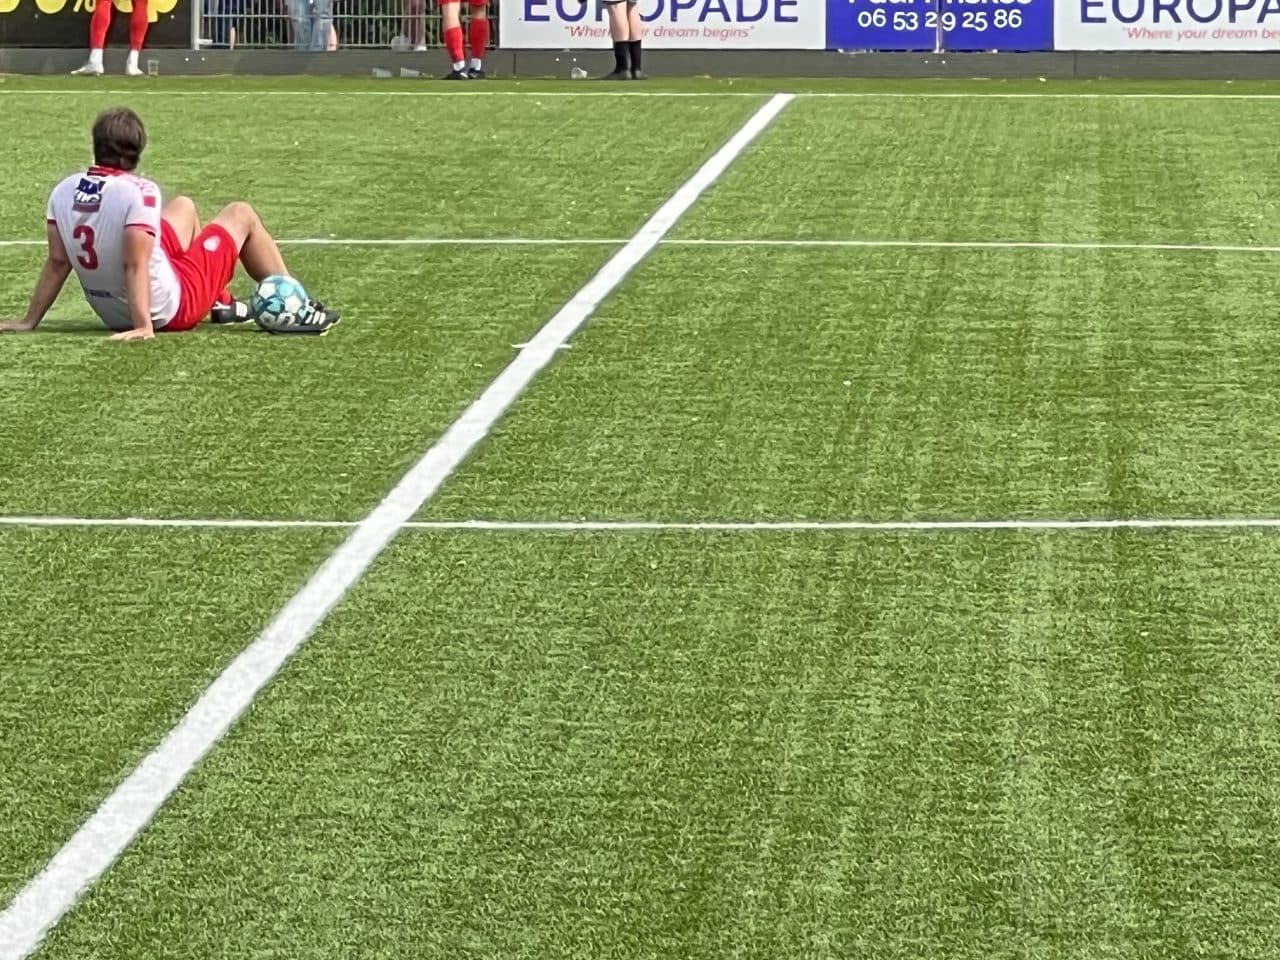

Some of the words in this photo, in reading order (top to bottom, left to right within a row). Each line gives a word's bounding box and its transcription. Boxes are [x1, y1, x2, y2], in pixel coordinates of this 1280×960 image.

[857, 8, 887, 28] 06
[893, 11, 919, 31] 53
[924, 11, 957, 32] 29
[962, 11, 988, 32] 25
[993, 8, 1023, 29] 86
[565, 24, 613, 39] "Wher
[653, 24, 700, 39] dream
[1176, 28, 1208, 41] your
[1211, 26, 1258, 39] dream
[72, 224, 99, 270] 3
